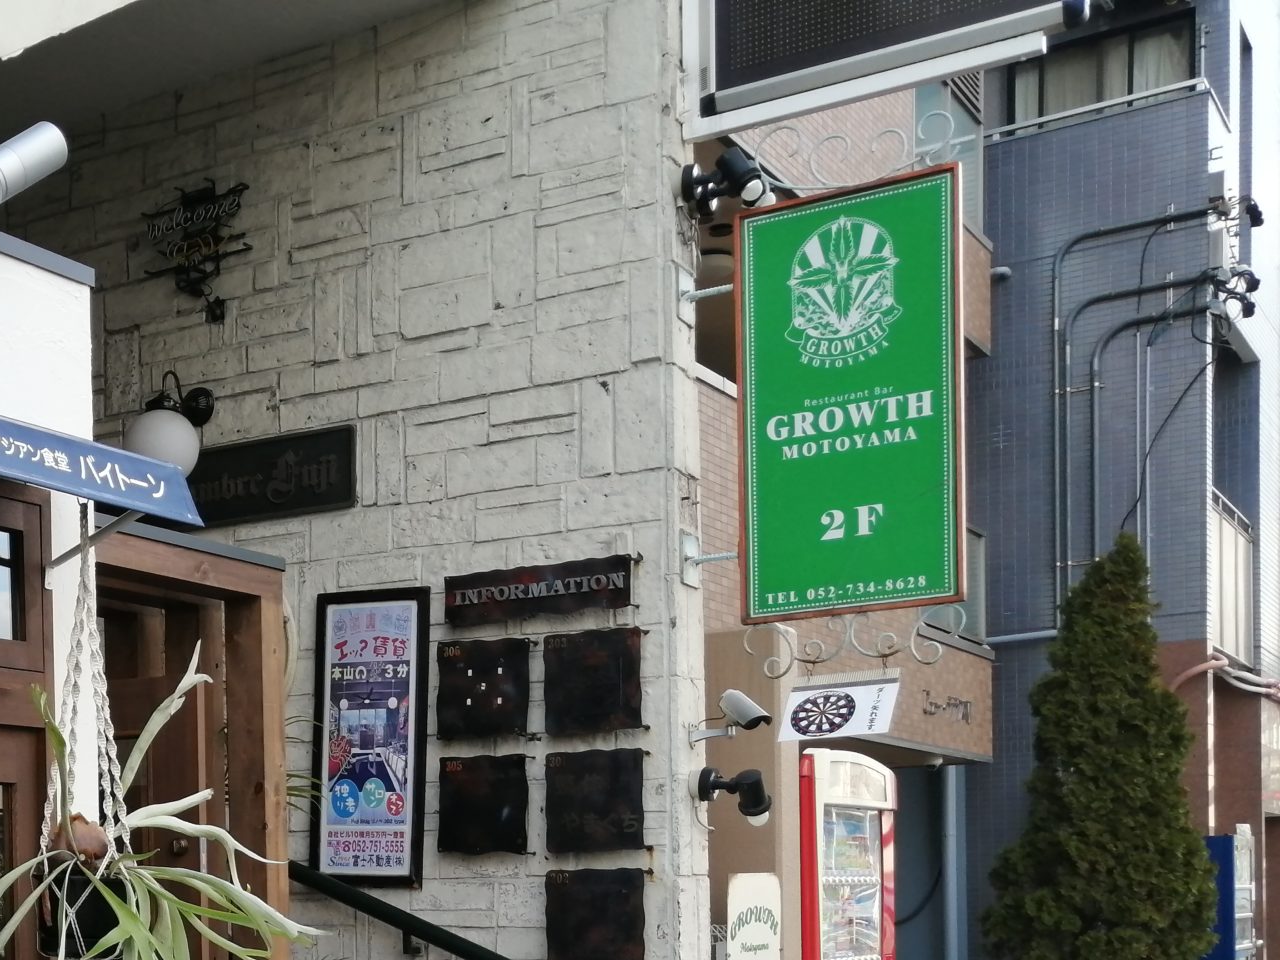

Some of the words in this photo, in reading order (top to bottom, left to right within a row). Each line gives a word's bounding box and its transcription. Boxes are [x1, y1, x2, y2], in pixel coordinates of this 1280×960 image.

[799, 339, 889, 368] MOTOYAMA
[806, 322, 884, 356] GROWTH
[804, 390, 869, 408] Restaurant
[873, 385, 894, 396] Bar
[766, 389, 934, 442] GROWTH
[781, 425, 918, 461] MOTOYAMA
[79, 454, 165, 498] バイトーン
[453, 572, 625, 606] INFORMATION
[765, 590, 799, 606] TEL
[806, 574, 927, 600] 052-734-8628
[446, 761, 462, 771] 305
